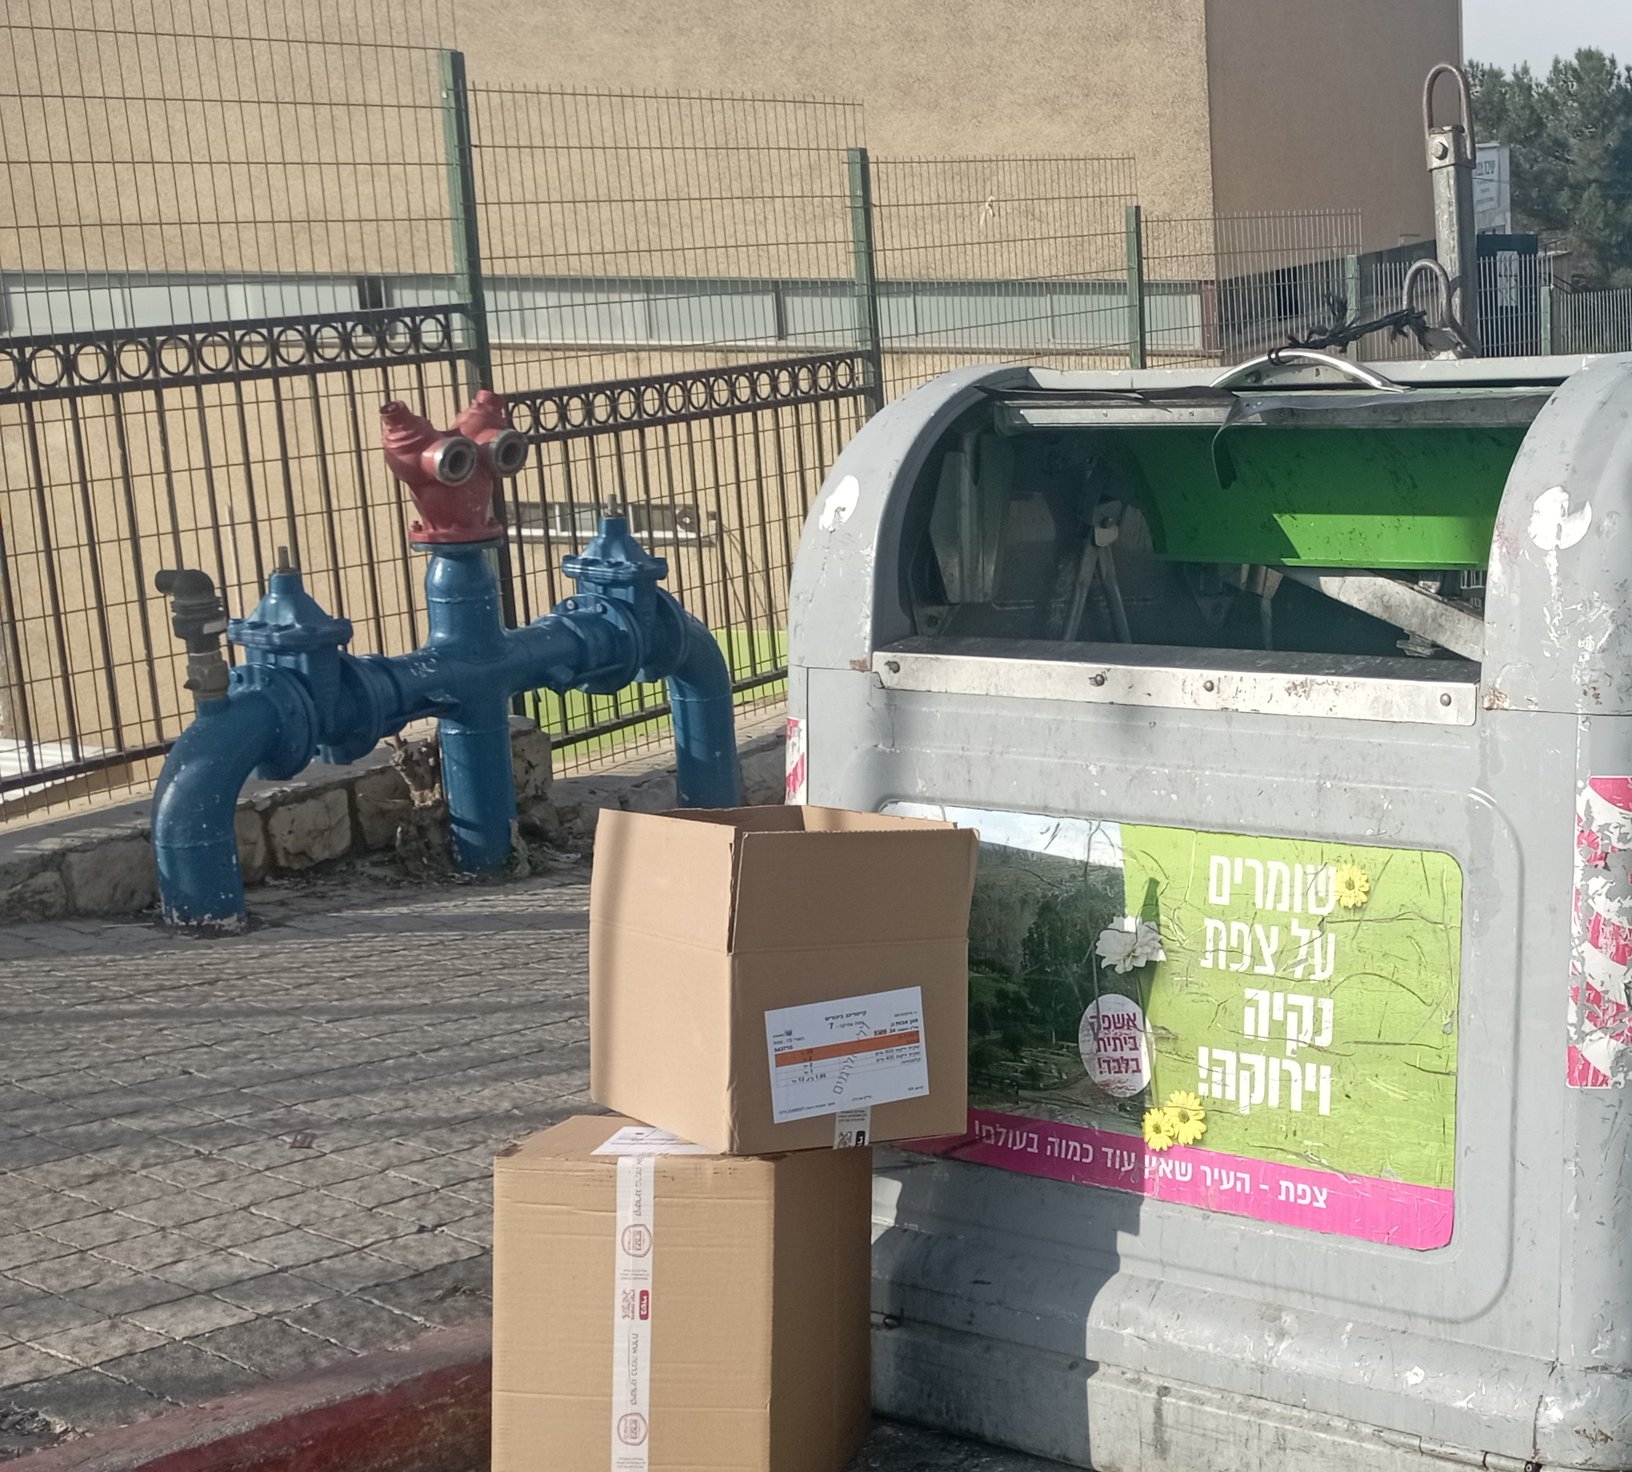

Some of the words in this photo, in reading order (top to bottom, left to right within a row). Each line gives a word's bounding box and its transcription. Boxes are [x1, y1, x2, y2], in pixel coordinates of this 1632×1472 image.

[1208, 855, 1337, 916] שומרים
[1199, 917, 1279, 975] צפת
[1290, 917, 1336, 983] על
[1243, 988, 1334, 1057] נקיה
[1096, 1035, 1139, 1052] ביתית
[1096, 1056, 1141, 1075] בלבד!
[1198, 1046, 1332, 1116] וירוקה!
[974, 1120, 1039, 1153] בעולם!
[1046, 1137, 1094, 1163] כמוה
[1101, 1147, 1136, 1172] עוד
[1144, 1154, 1193, 1181] שאין
[1200, 1165, 1250, 1194] העיר
[1278, 1180, 1328, 1209] צפת
